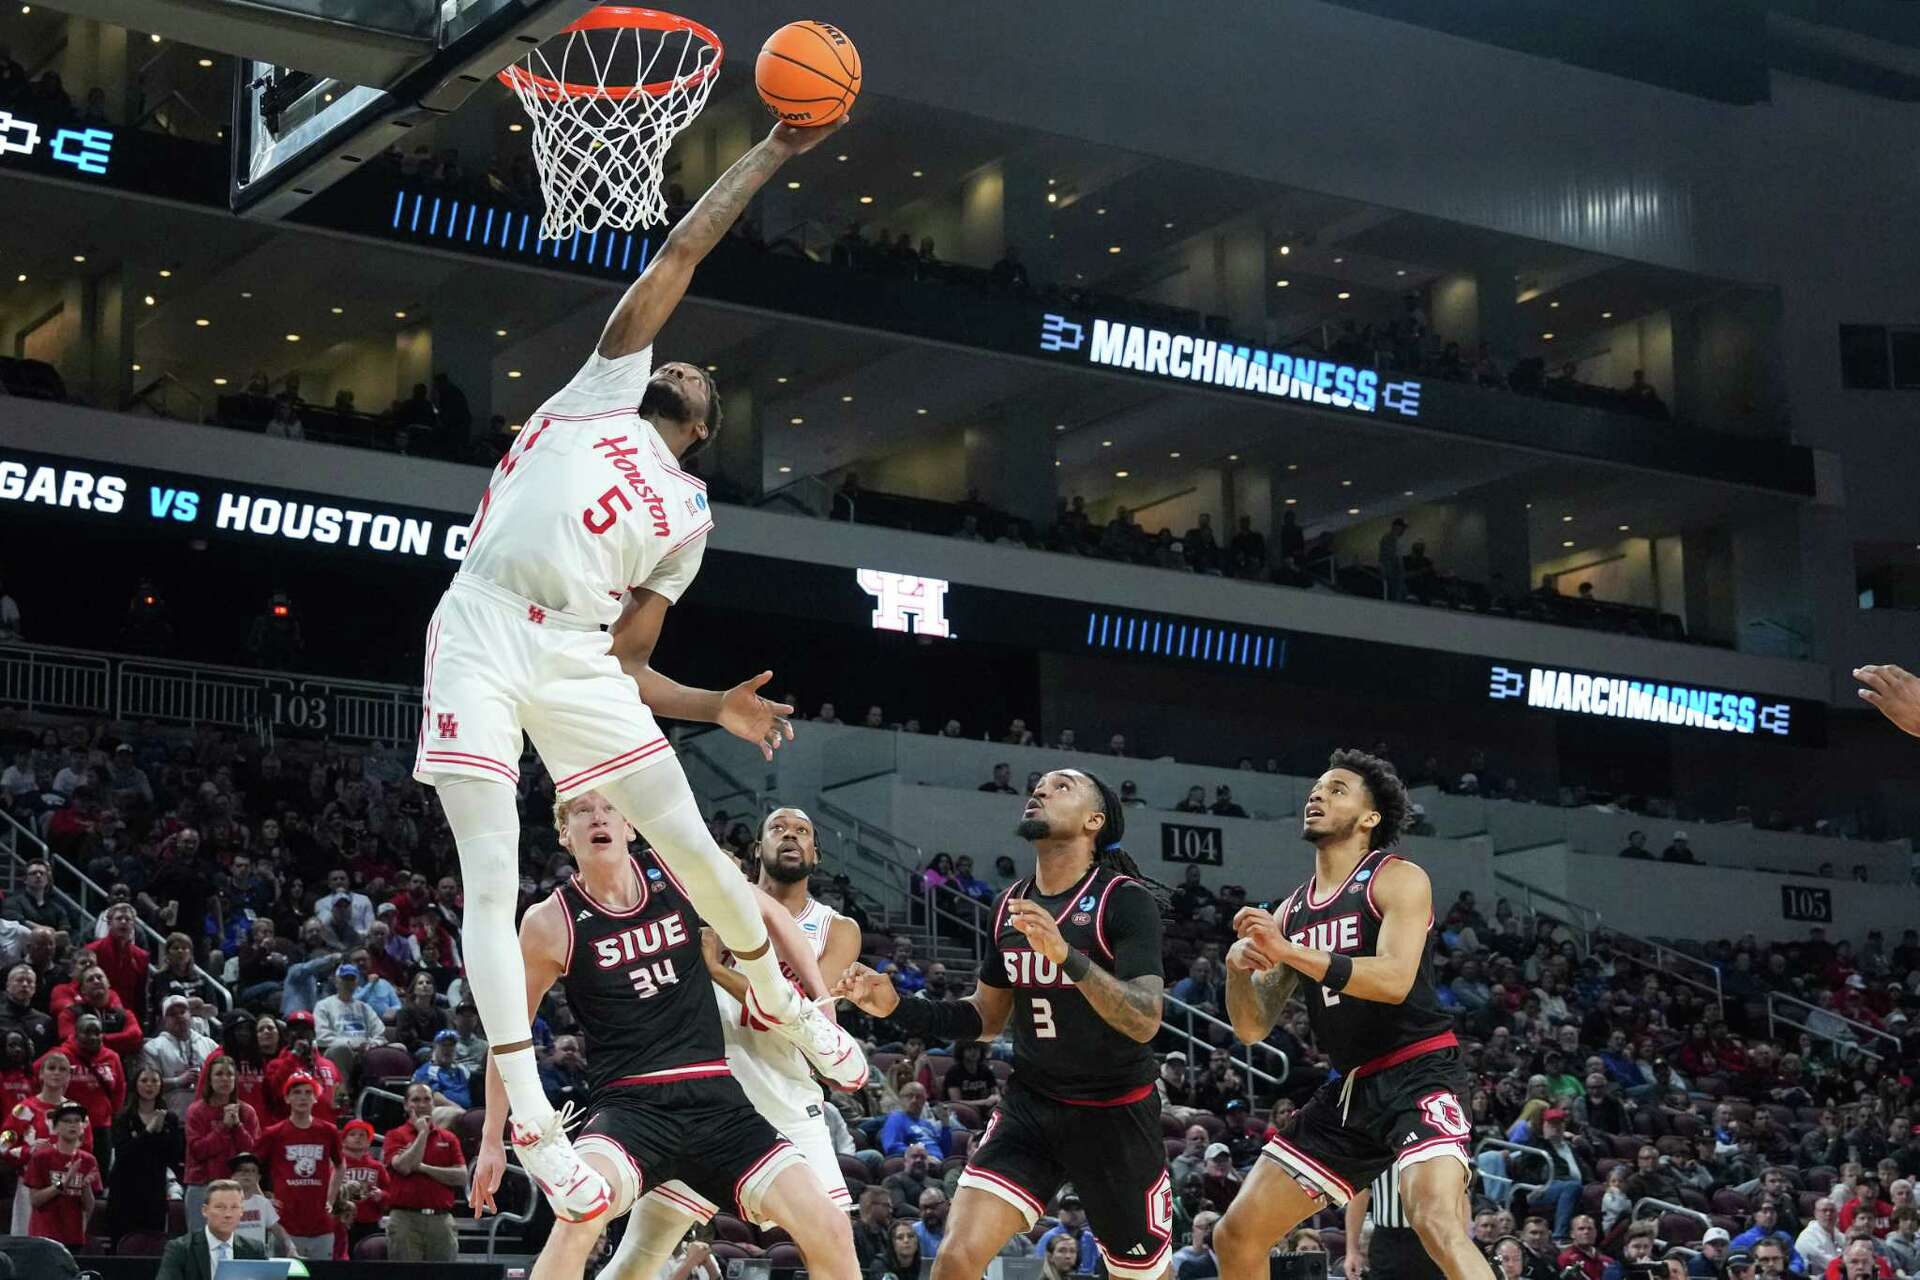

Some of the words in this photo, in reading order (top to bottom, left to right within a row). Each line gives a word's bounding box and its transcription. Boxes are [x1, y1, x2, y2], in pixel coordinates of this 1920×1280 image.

[1090, 319, 1378, 412] MARCHMADNESS
[593, 435, 671, 538] Houston
[150, 486, 199, 522] VS
[216, 493, 433, 556] HOUSTON
[583, 485, 633, 535] 5
[271, 693, 327, 728] 103
[1528, 668, 1756, 734] MARCHMADNESS
[1170, 828, 1217, 860] 104
[1787, 889, 1826, 918] 105
[594, 913, 688, 968] SIUE
[628, 958, 680, 999] 34
[1003, 951, 1075, 985] SIU
[1031, 998, 1057, 1039] 3
